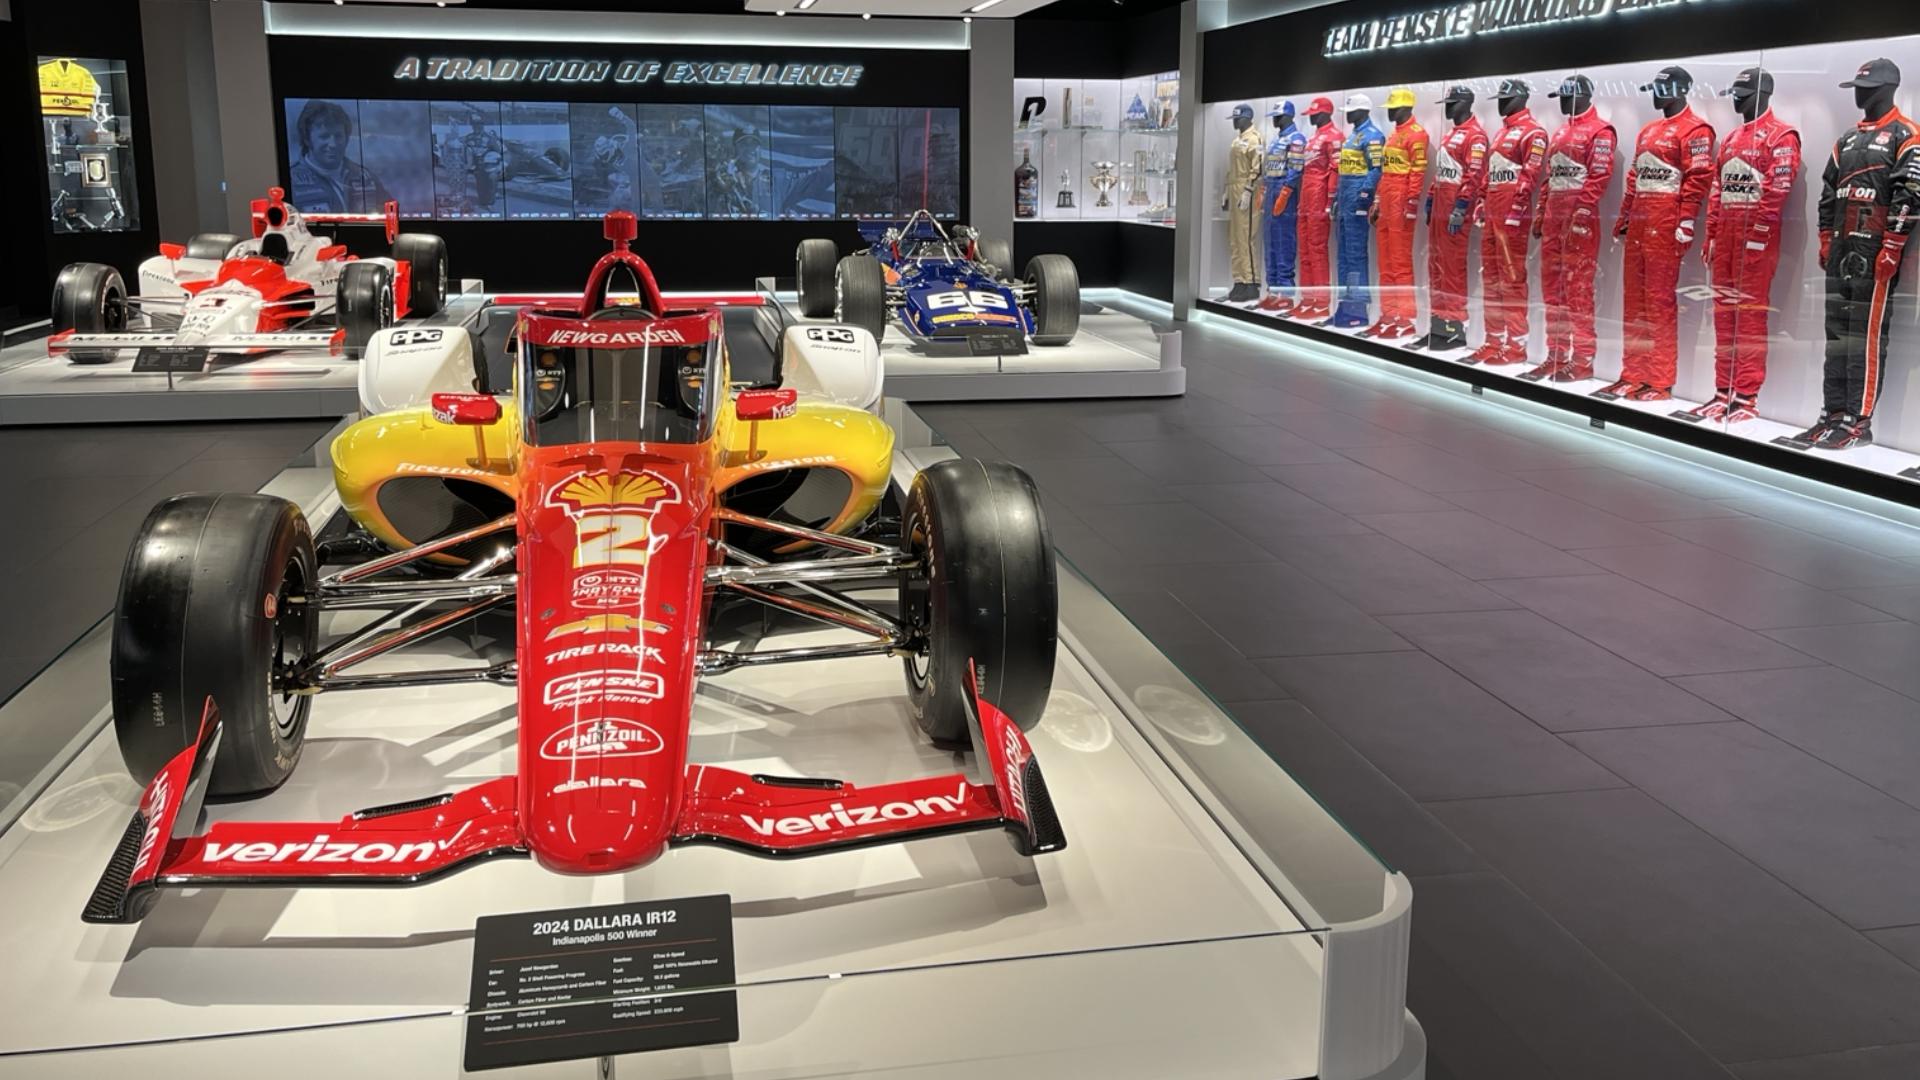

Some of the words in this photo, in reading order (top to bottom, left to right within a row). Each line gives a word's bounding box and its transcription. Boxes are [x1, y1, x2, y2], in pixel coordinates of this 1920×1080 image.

[1320, 21, 1375, 56] TEAM
[1375, 3, 1477, 48] PENSKE
[394, 57, 421, 79] A
[426, 57, 608, 82] TRADITION
[614, 61, 662, 83] OF
[664, 62, 864, 87] EXCELLENCE
[1836, 183, 1876, 199] erizon
[926, 290, 1009, 310] 66
[390, 329, 443, 346] PPG
[547, 329, 686, 344] NEWGARDEN
[807, 328, 855, 343] PPG
[573, 515, 650, 568] 2
[545, 644, 597, 665] TIRE
[598, 643, 667, 665] RACK
[553, 676, 657, 696] PENSKE
[552, 697, 596, 711] Truck
[556, 729, 646, 754] PENNZOIL
[553, 776, 648, 793] dallara
[741, 794, 955, 837] verizon
[203, 834, 435, 863] verizon
[533, 920, 570, 935] 2024
[574, 913, 643, 931] DALLARA
[647, 910, 677, 924] IR12
[552, 932, 605, 946] Indianapolis
[607, 930, 625, 941] 500
[626, 928, 658, 940] Winner
